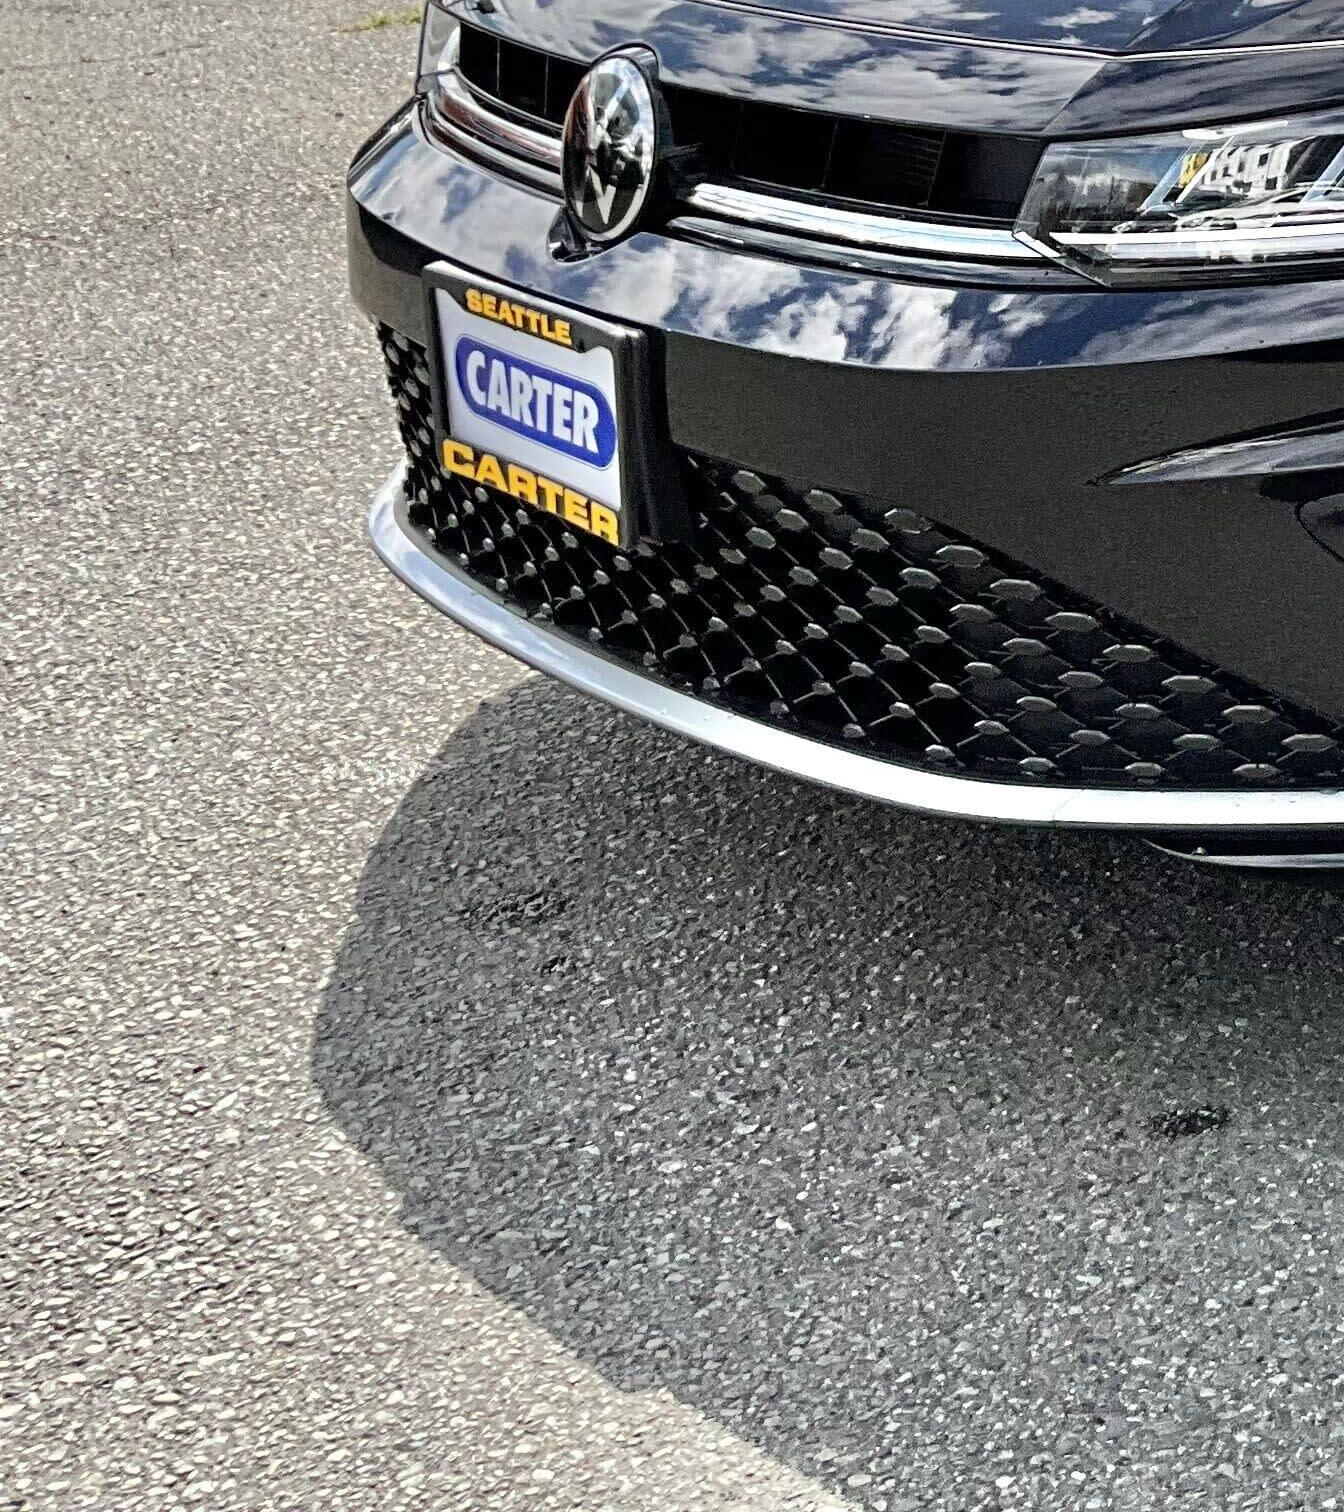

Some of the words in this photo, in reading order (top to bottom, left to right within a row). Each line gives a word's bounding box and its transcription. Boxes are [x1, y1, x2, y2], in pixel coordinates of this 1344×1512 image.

[465, 288, 573, 345] SEATTLE
[466, 349, 599, 453] CARTER
[442, 438, 619, 546] CARTER
